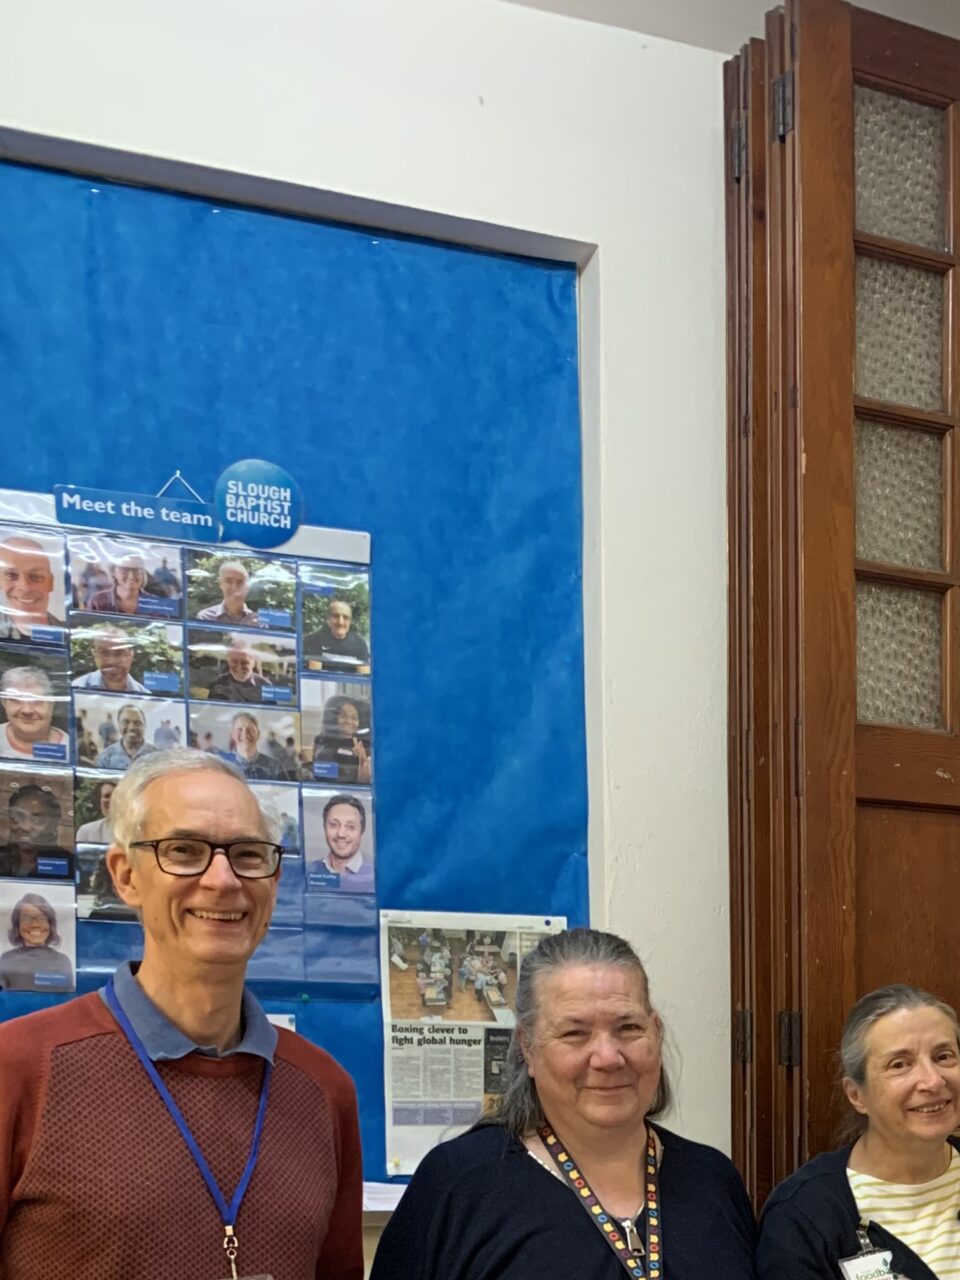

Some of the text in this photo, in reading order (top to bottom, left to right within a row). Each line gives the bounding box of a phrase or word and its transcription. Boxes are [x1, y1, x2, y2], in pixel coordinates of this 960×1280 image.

[227, 480, 291, 501] SLOUGH
[62, 492, 213, 527] Meet the team
[225, 494, 291, 516] BAPTIST
[226, 509, 291, 529] CHURCH
[391, 1024, 468, 1035] Boxing clever to
[392, 1035, 414, 1047] fight
[417, 1036, 446, 1047] global
[449, 1037, 482, 1047] hunger
